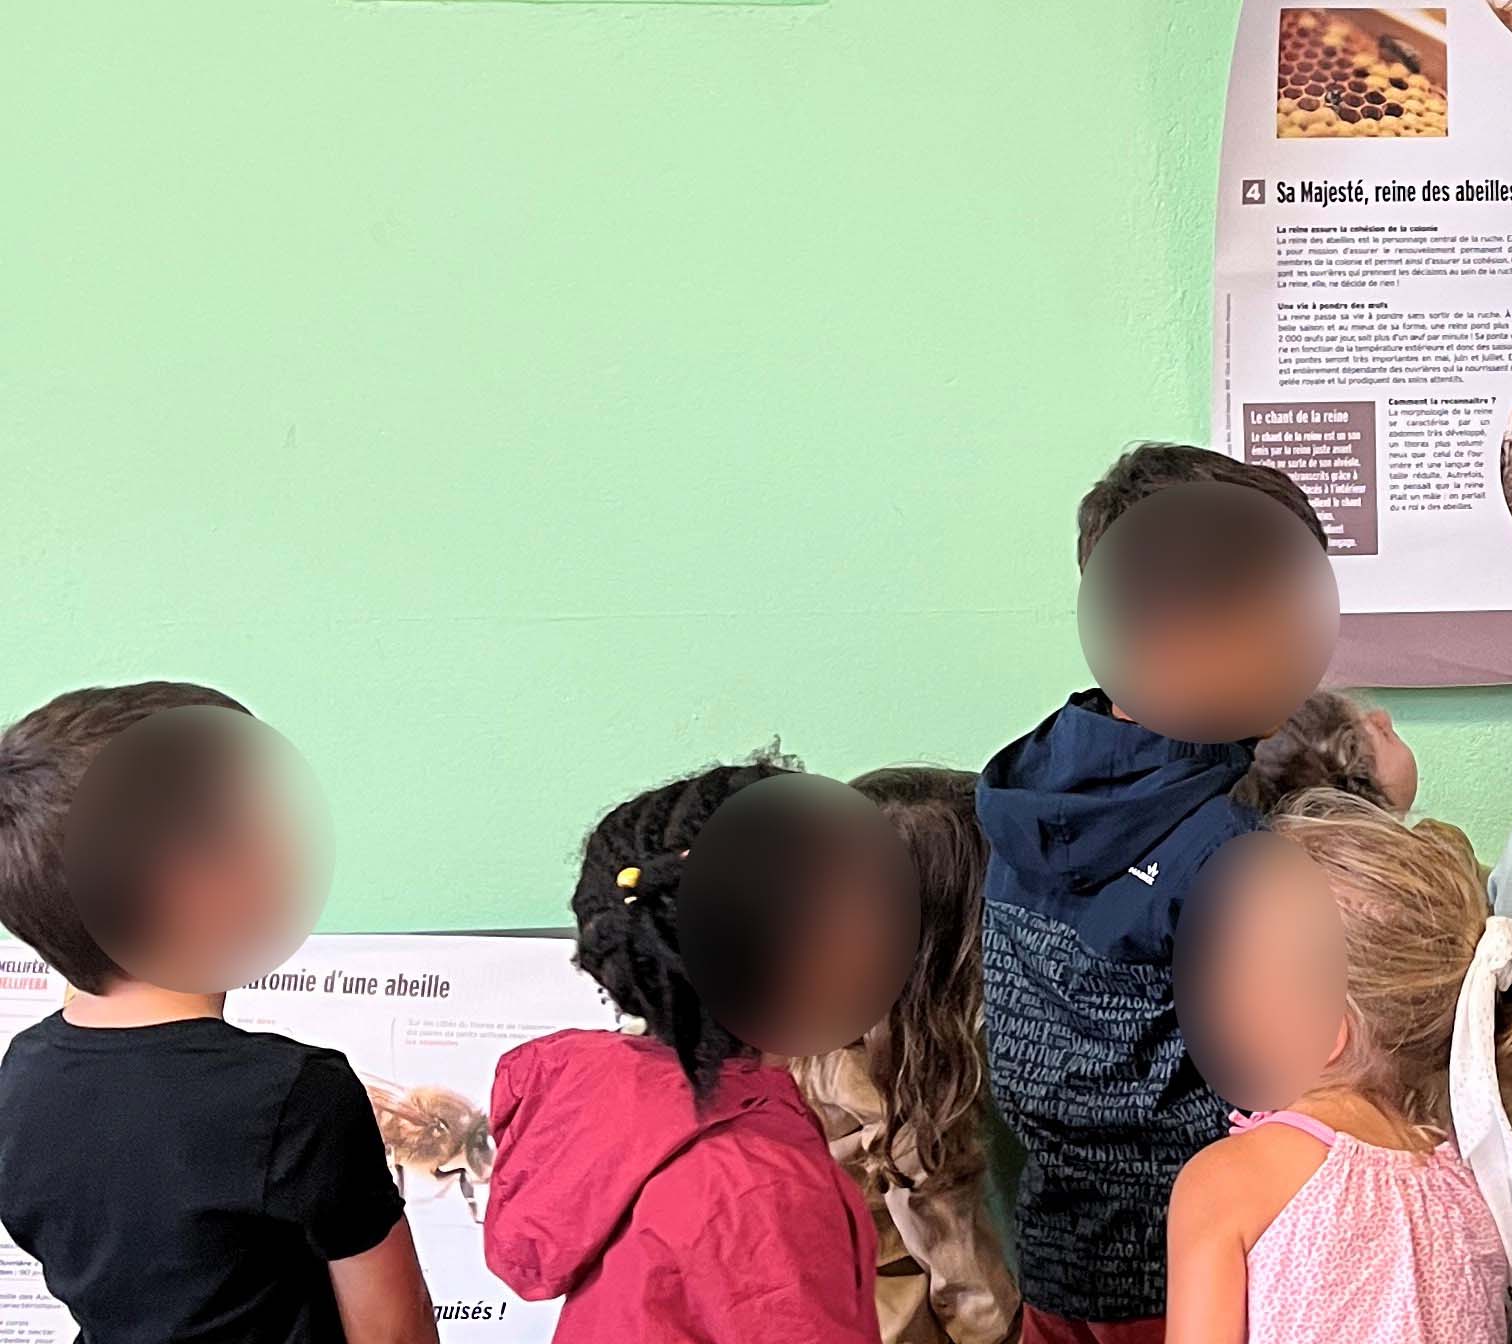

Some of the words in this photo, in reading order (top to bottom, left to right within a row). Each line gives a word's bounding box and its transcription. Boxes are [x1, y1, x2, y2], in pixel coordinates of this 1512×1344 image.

[1245, 182, 1261, 201] 4
[1277, 181, 1295, 203] Sa
[1300, 179, 1369, 208] Majesté,
[1374, 179, 1415, 202] reine
[1422, 179, 1449, 201] des
[1388, 397, 1427, 405] Comment
[1251, 410, 1262, 424] Le
[1265, 409, 1293, 424] chant
[1296, 409, 1308, 423] de
[1310, 409, 1321, 423] la
[1323, 408, 1348, 423] reine
[242, 968, 316, 992] tomie
[324, 969, 377, 995] d'une
[386, 972, 450, 998] abeille
[499, 1302, 506, 1320] !
